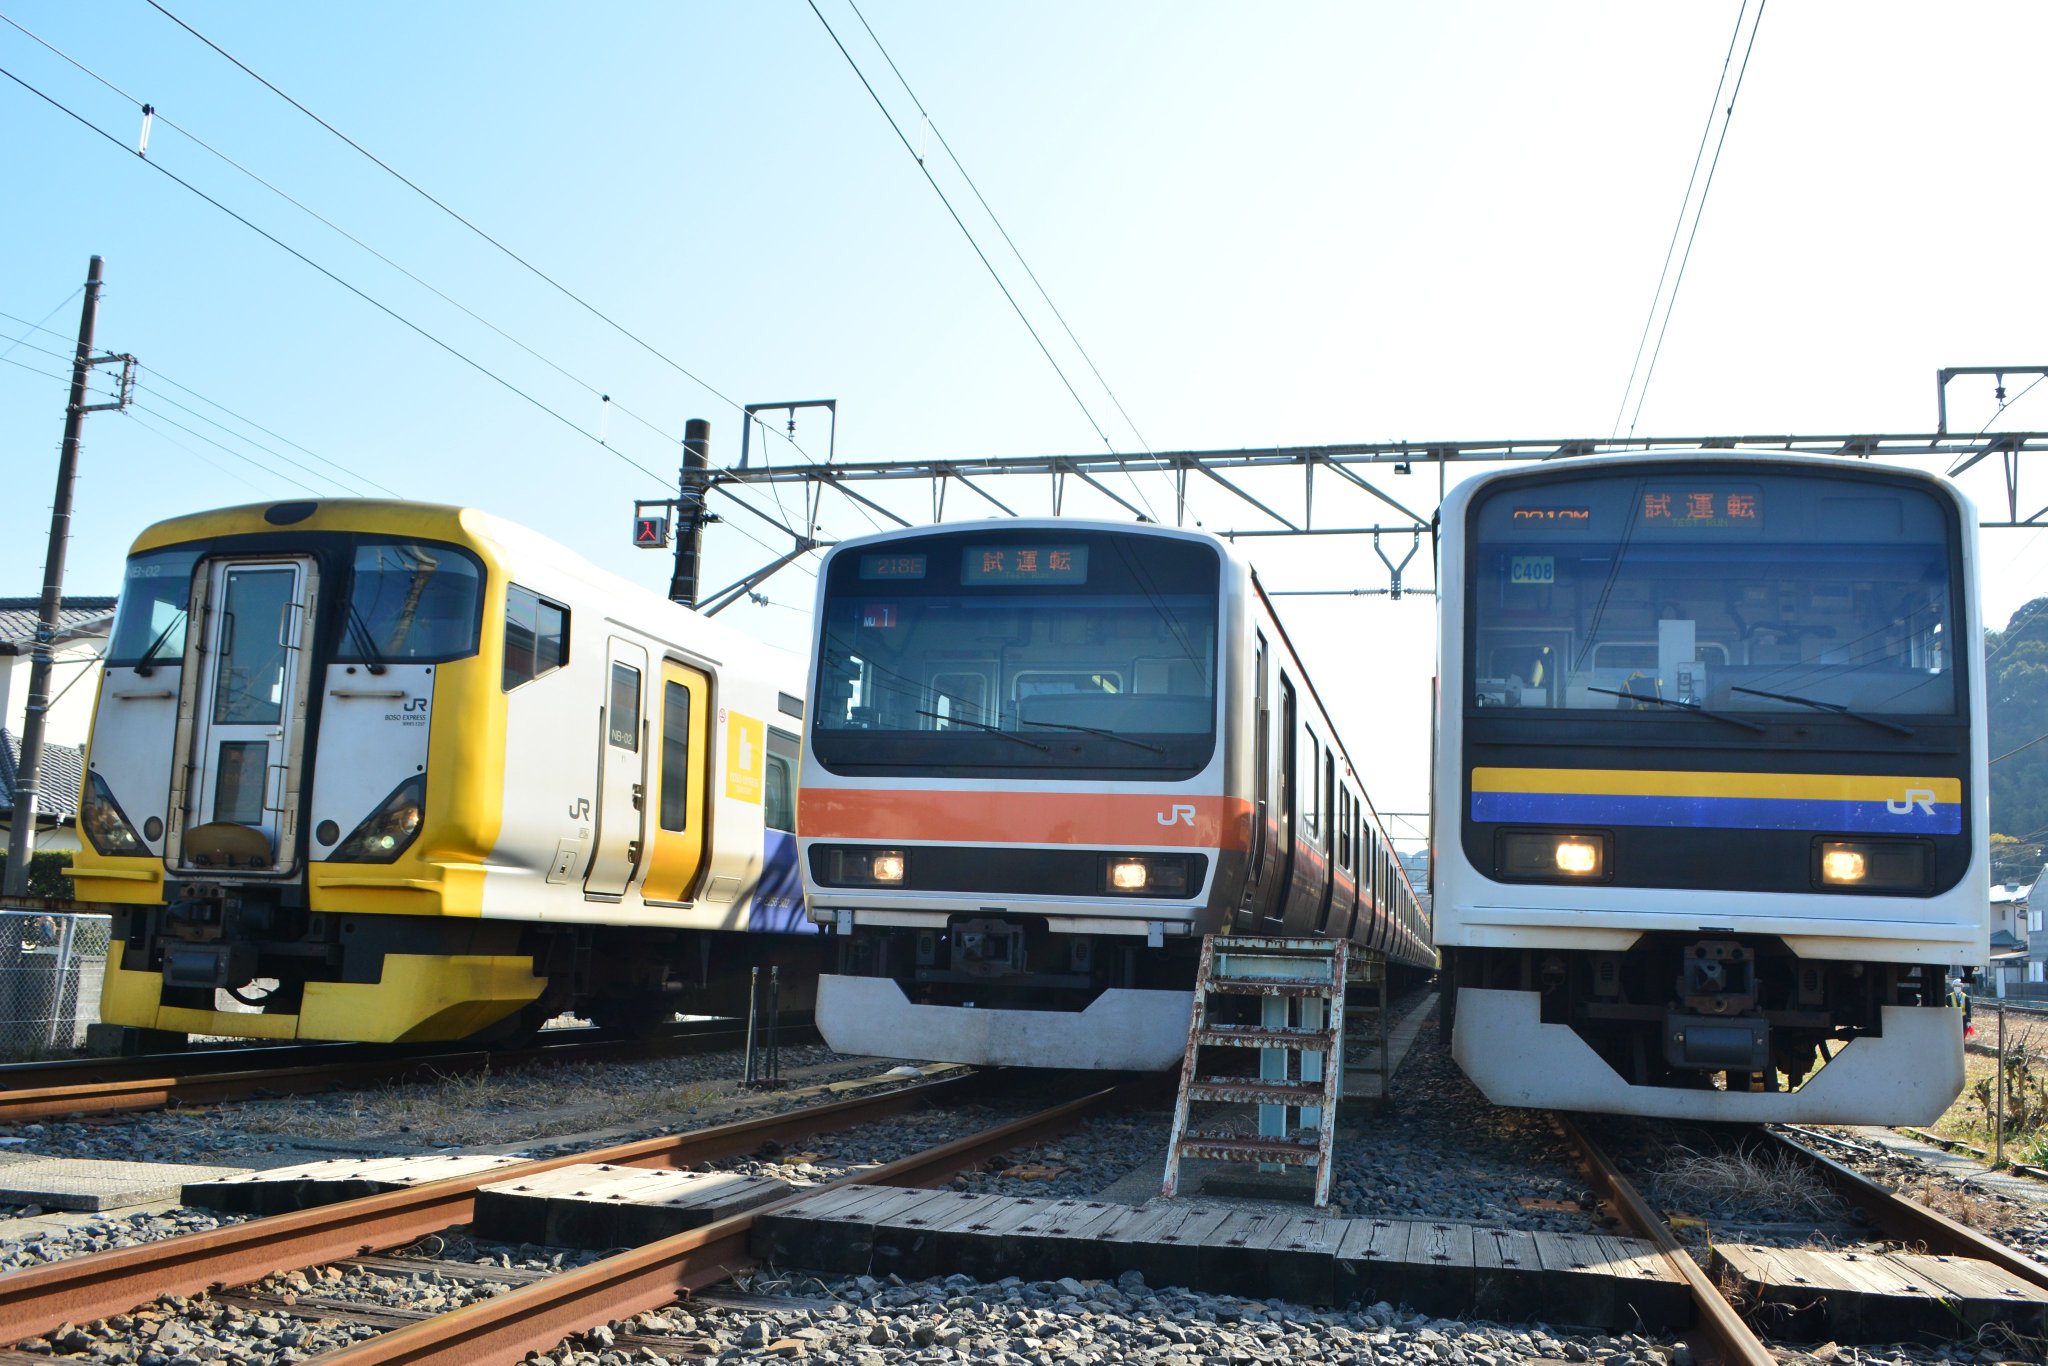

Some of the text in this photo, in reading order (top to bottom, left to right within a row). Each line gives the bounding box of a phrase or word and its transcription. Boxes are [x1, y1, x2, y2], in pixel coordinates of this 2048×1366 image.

[1645, 493, 1755, 519] 試運転
[983, 550, 1071, 573] 試運転
[1513, 563, 1553, 580] C408
[404, 698, 428, 712] JR
[611, 729, 633, 745] NB-02
[569, 797, 590, 822] JR
[1886, 788, 1937, 815] JR
[1157, 804, 1196, 826] JR
